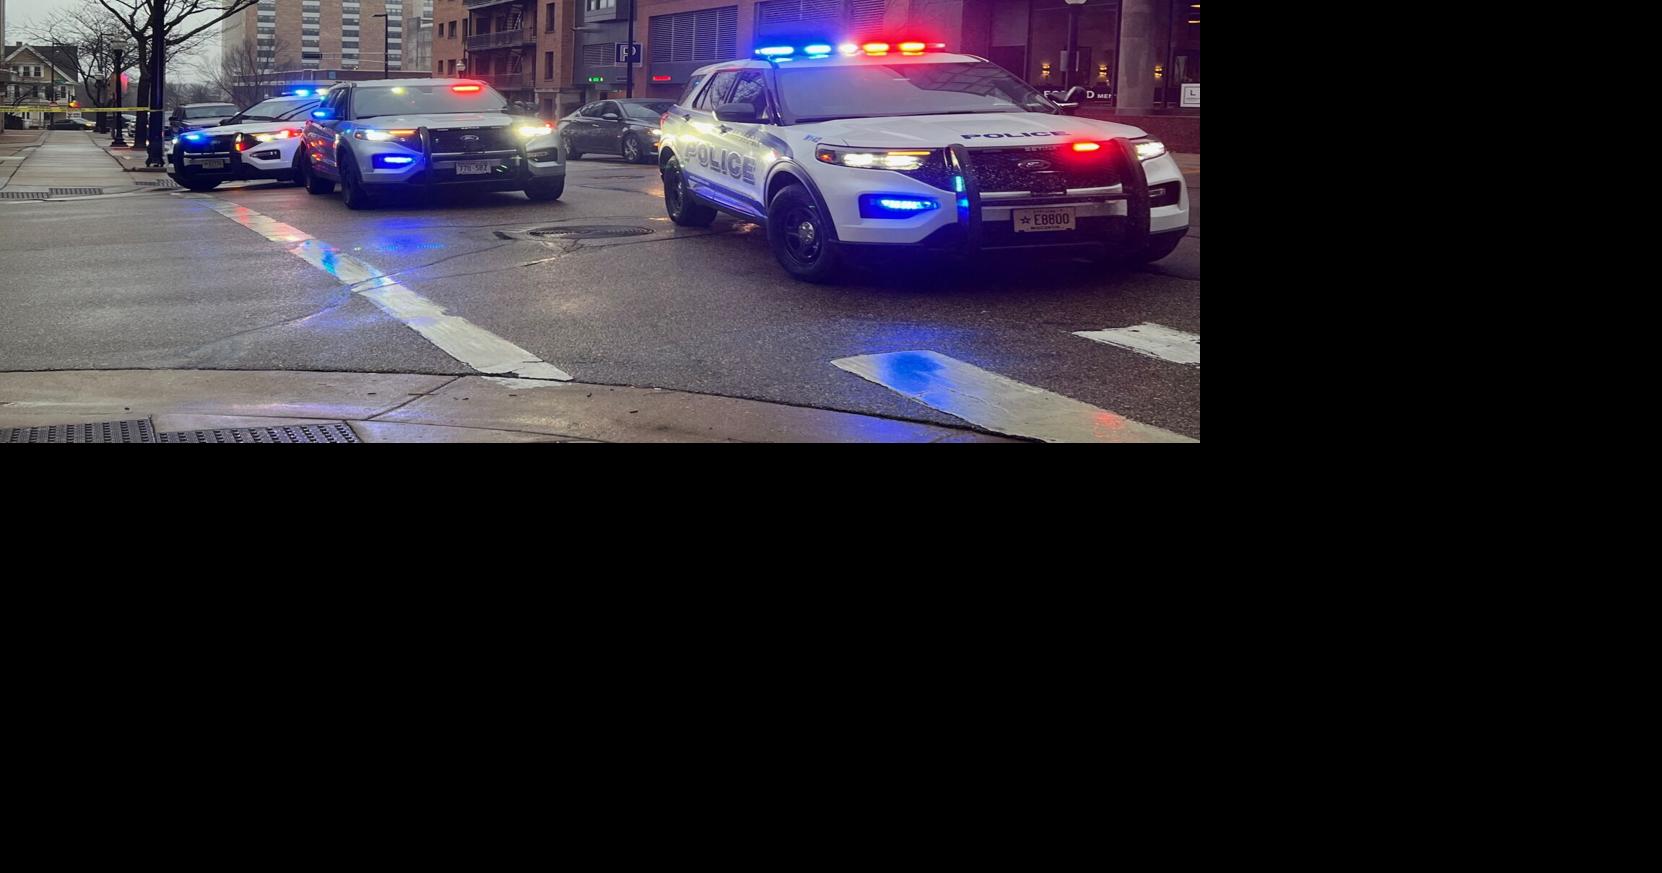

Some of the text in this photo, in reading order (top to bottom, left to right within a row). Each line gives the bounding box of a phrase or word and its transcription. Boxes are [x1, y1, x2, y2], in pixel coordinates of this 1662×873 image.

[619, 44, 637, 61] P
[960, 130, 1070, 140] POLICE
[684, 141, 757, 185] POLICE
[1034, 213, 1070, 226] E8800
